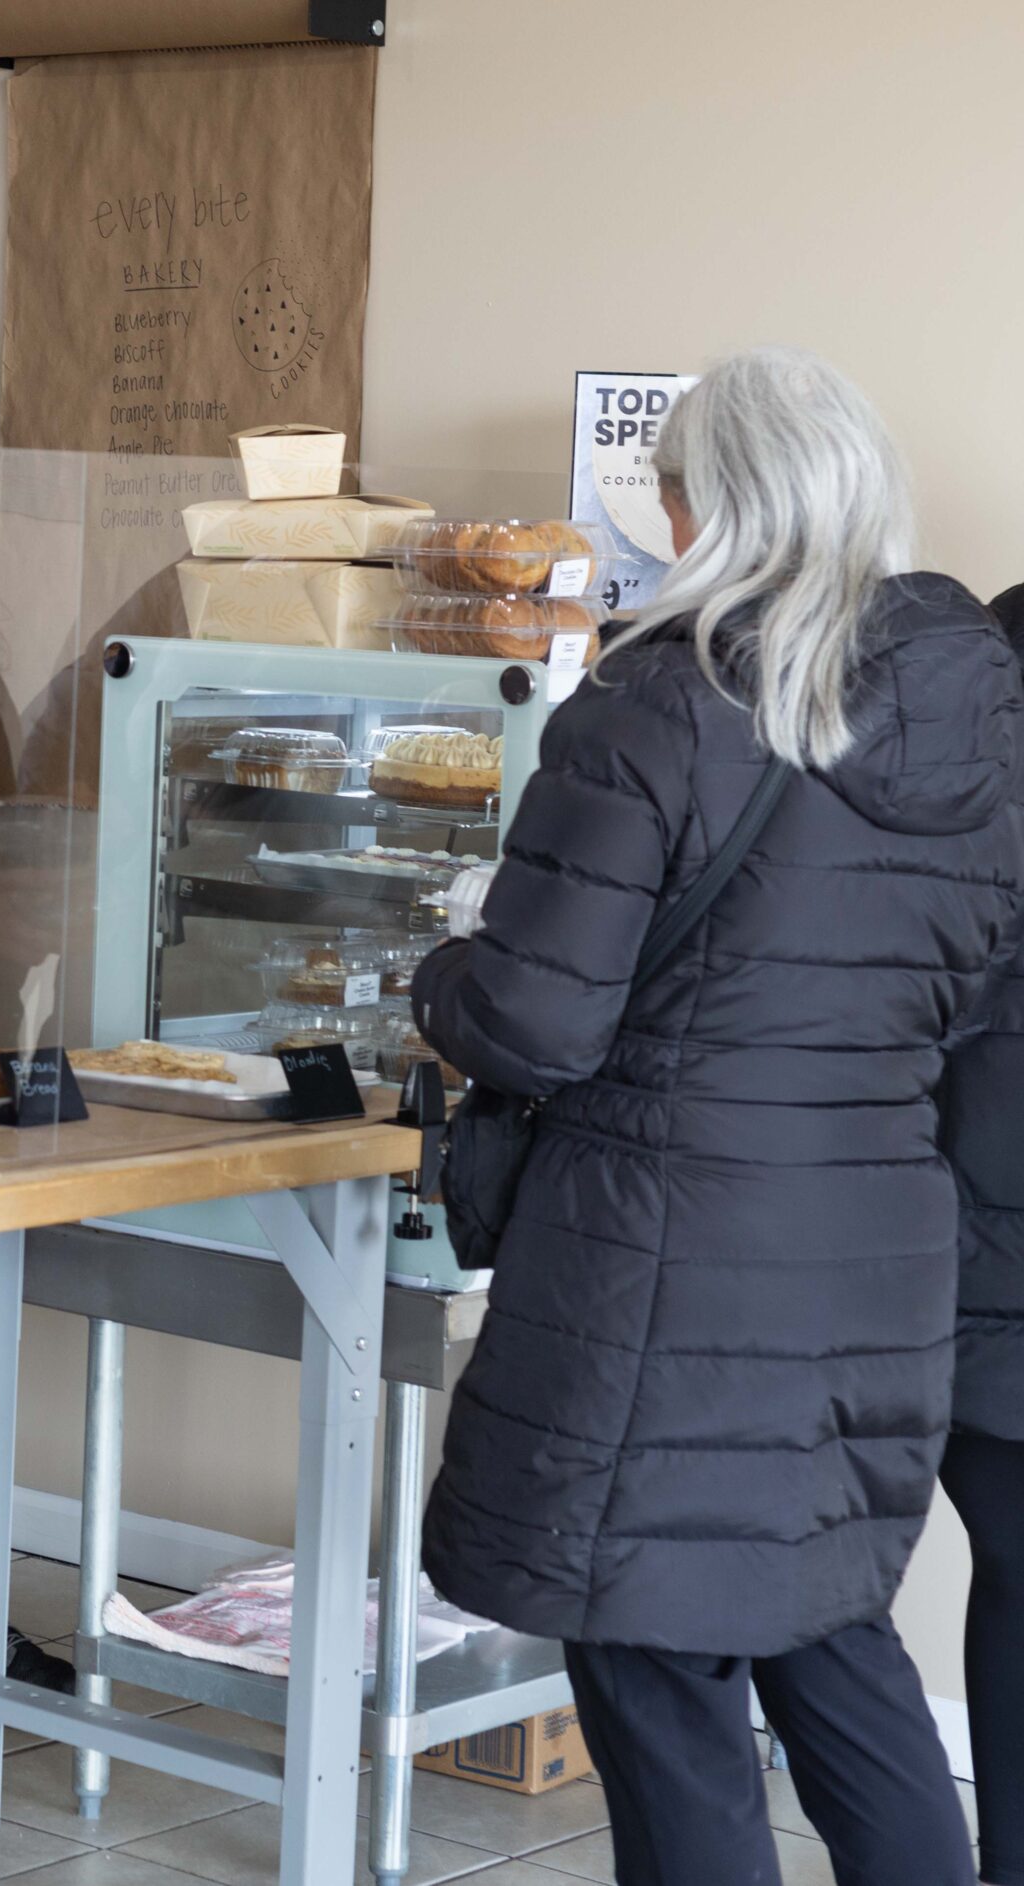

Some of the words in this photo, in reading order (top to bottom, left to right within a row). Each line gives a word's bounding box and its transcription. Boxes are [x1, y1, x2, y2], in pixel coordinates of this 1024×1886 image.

[89, 190, 176, 256] every
[192, 183, 251, 228] bite
[122, 258, 203, 286] BAKERY
[270, 327, 326, 400] COOKIES
[112, 374, 165, 394] Banana
[595, 387, 670, 416] TOD
[110, 404, 158, 431] Orange
[594, 418, 659, 448] SPE
[107, 434, 145, 464] Apple
[153, 434, 175, 456] Pie
[633, 455, 649, 465] BI
[103, 472, 151, 497] Peanut
[158, 470, 205, 496] Butter
[602, 475, 661, 487] COOKI
[100, 504, 165, 529] Chocolate
